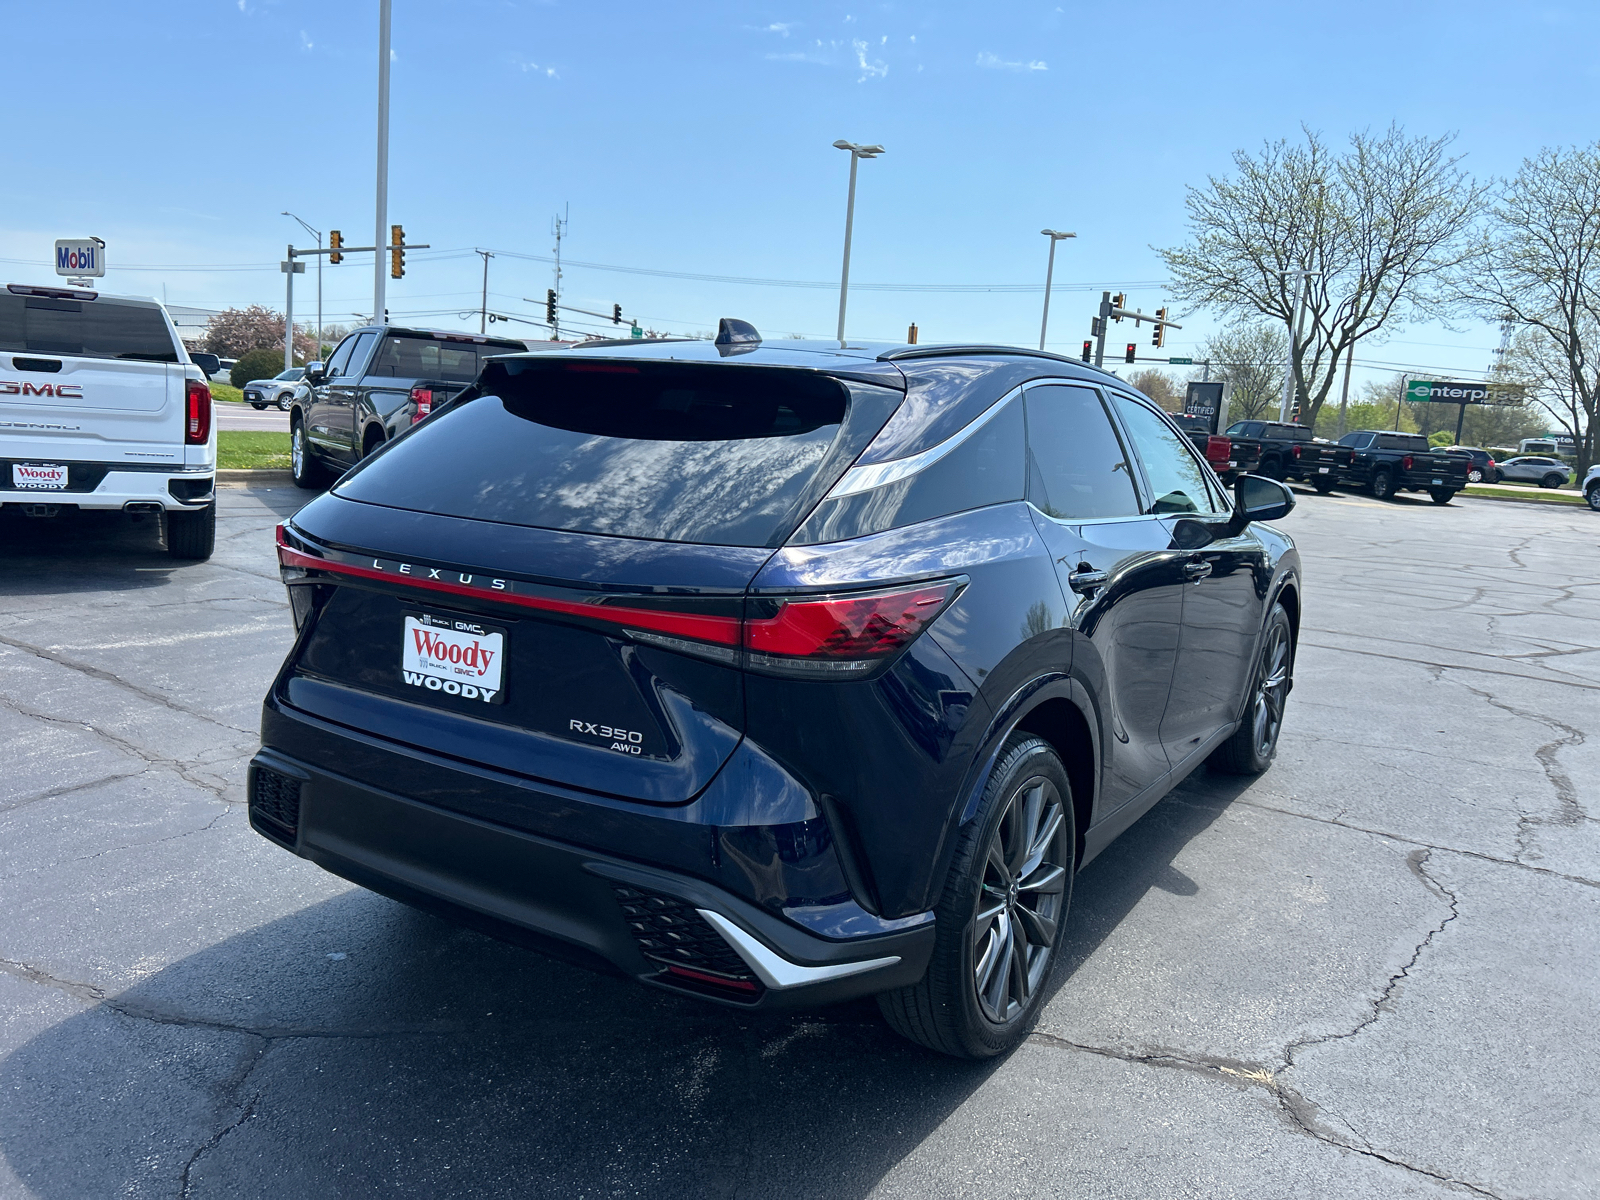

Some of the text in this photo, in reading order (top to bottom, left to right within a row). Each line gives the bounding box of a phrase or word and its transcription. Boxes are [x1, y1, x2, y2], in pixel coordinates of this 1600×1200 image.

[57, 246, 95, 269] Mobil
[0, 380, 84, 399] GMC
[1407, 385, 1522, 402] enterprise
[1187, 406, 1214, 414] CERTIFIED
[0, 421, 80, 430] DENALI
[17, 467, 64, 481] Woody
[373, 559, 506, 590] LEXUS
[432, 618, 482, 633] BUICK GMC
[412, 628, 495, 676] Woody
[428, 662, 475, 677] BUICK GMC
[402, 670, 497, 703] WOODY
[569, 719, 643, 744] RX350
[610, 742, 642, 755] AWD
